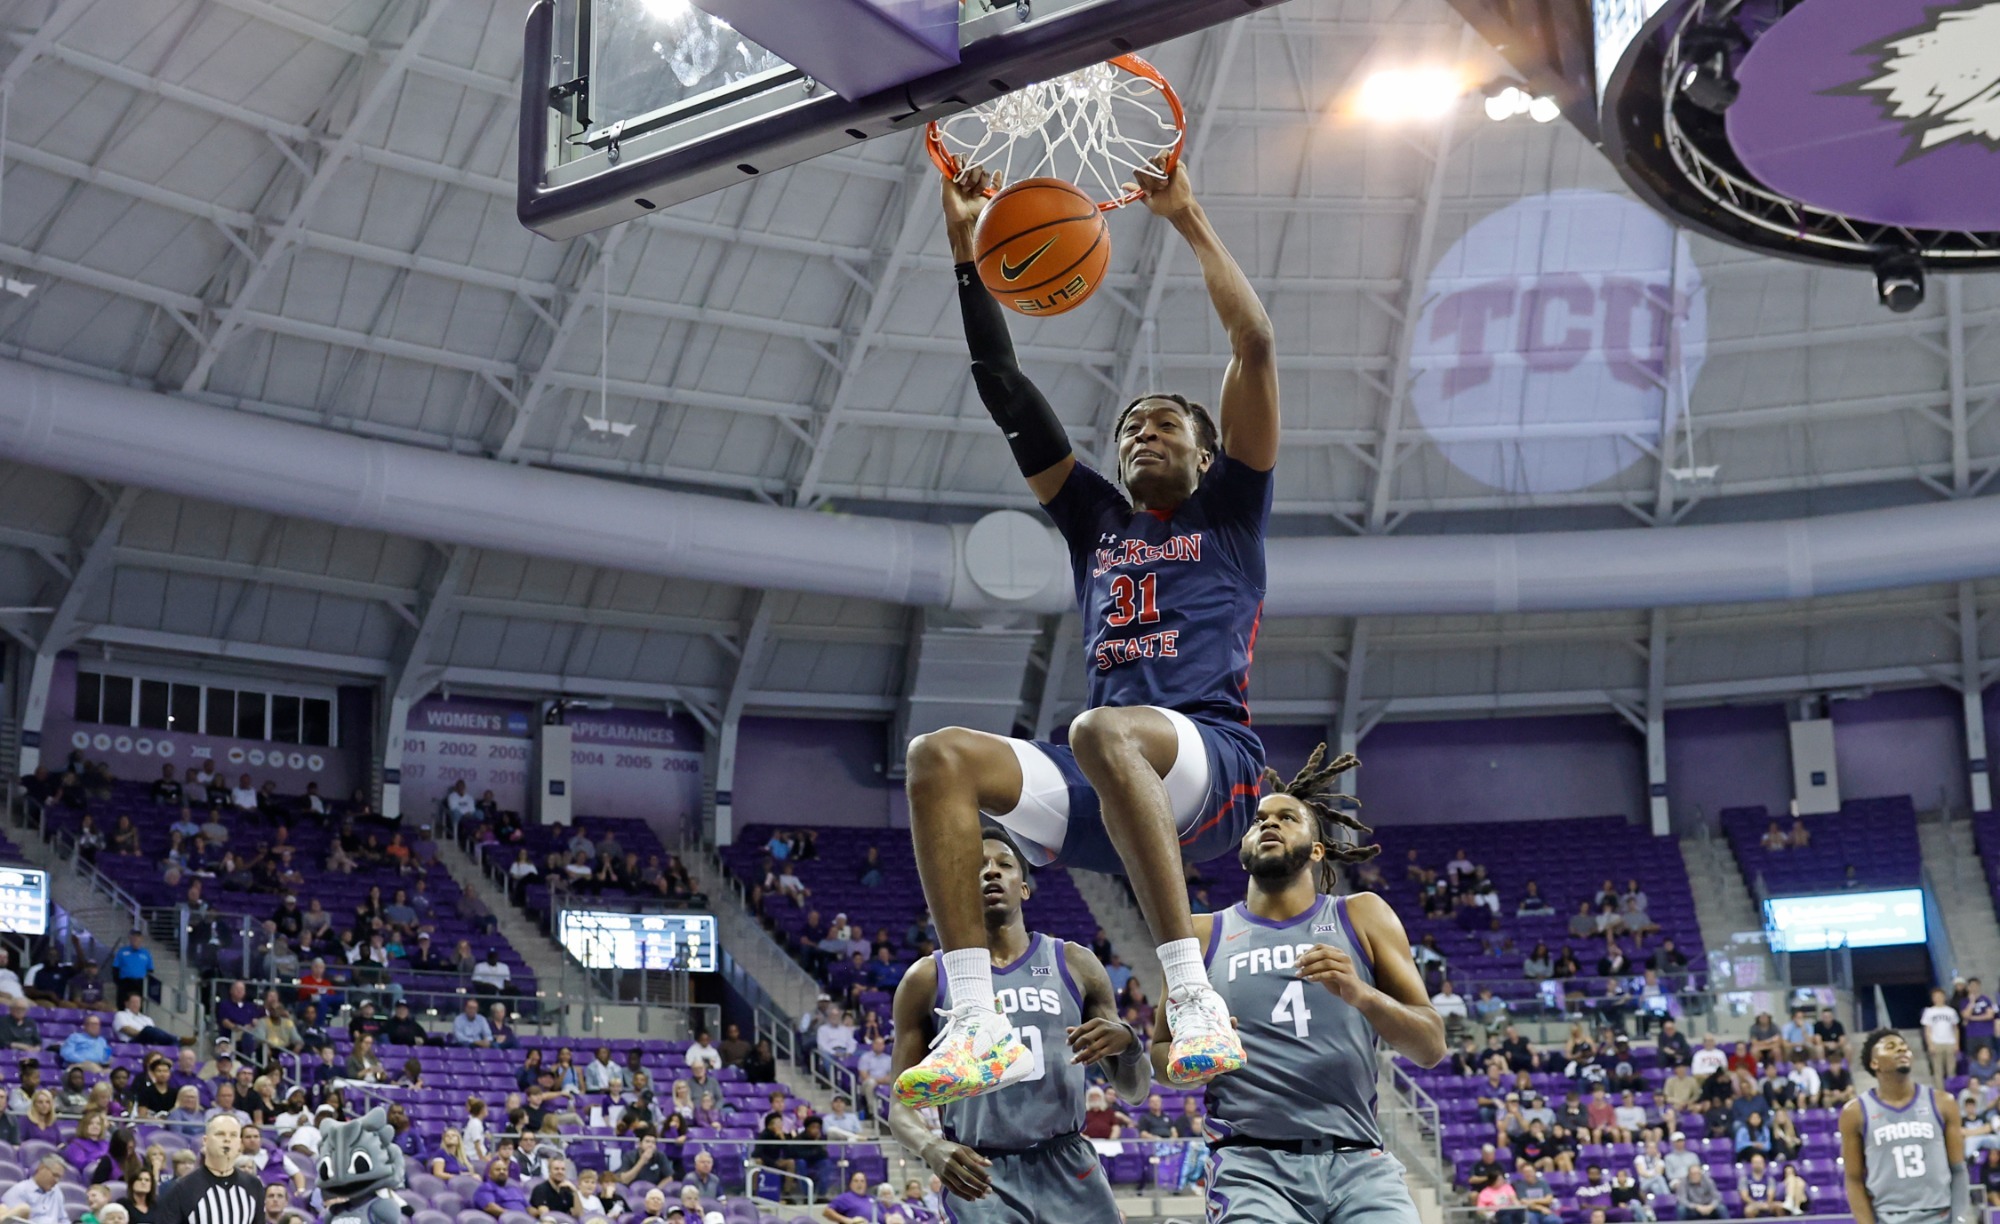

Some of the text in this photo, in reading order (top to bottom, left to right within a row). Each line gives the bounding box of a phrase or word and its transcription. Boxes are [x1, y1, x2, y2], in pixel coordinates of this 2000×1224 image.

[1014, 273, 1087, 312] ELITE
[1429, 271, 1691, 401] TCU
[1092, 532, 1202, 578] JACKSON
[1106, 572, 1160, 627] 31
[1095, 629, 1179, 670] STATE
[427, 710, 675, 744] WOMEN'S APPEARANCES
[402, 739, 699, 773] 01 2002 2003 2004 2005 2006
[1228, 943, 1316, 982] FRO
[996, 986, 1061, 1015] OGS
[1271, 980, 1312, 1038] 4
[1012, 1025, 1046, 1082] 0
[1873, 1121, 1935, 1146] FROGS
[1892, 1143, 1926, 1179] 13
